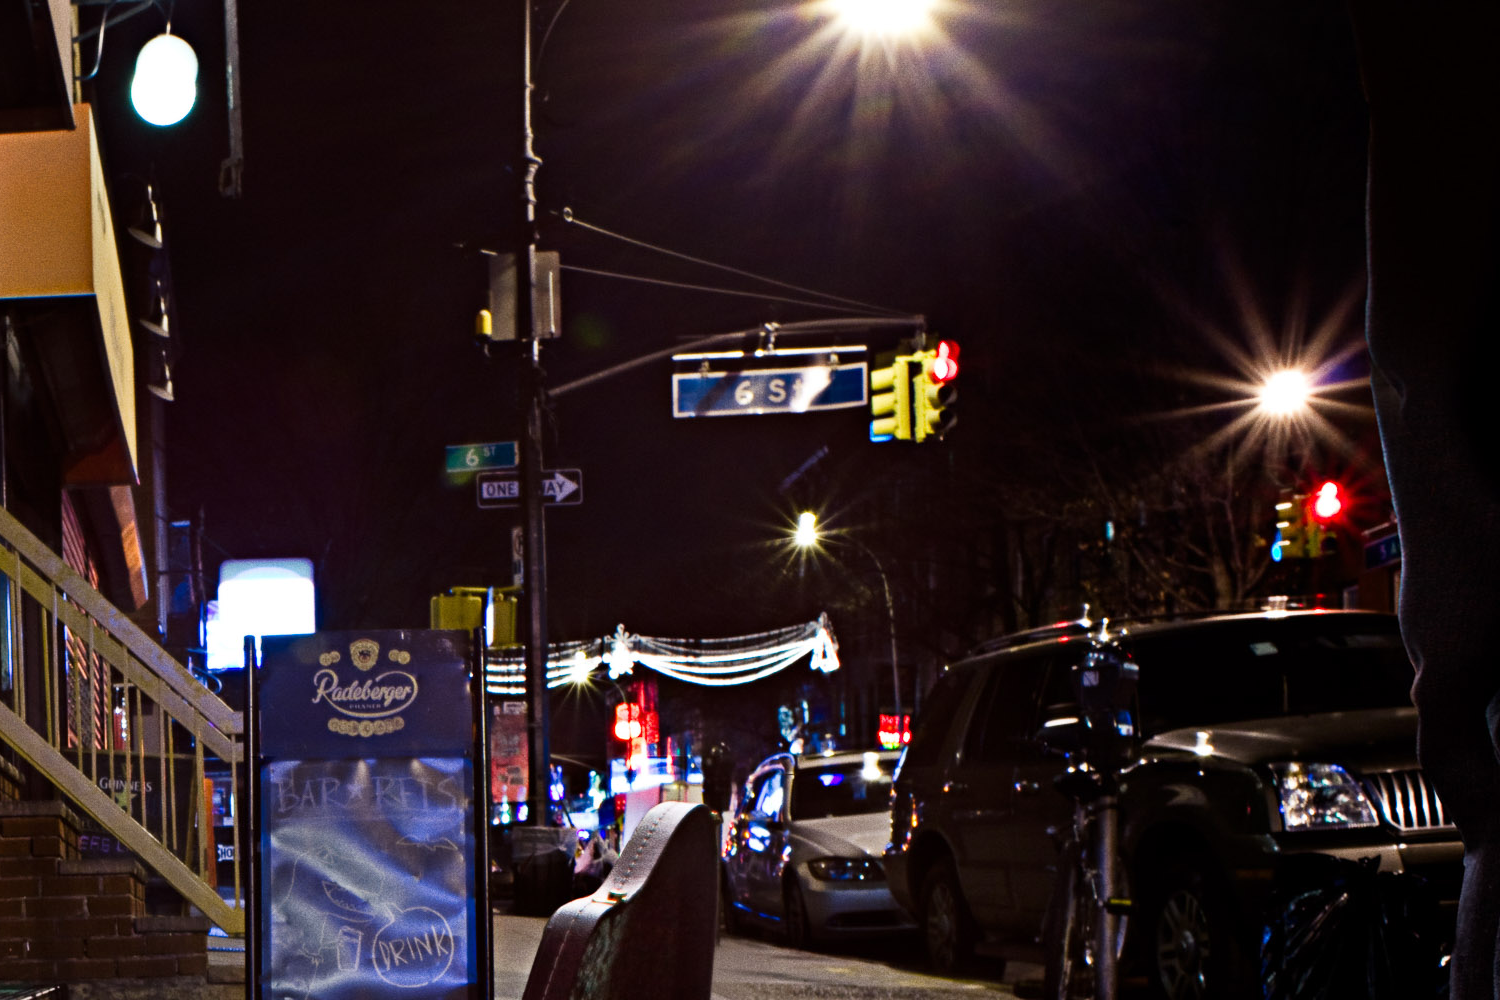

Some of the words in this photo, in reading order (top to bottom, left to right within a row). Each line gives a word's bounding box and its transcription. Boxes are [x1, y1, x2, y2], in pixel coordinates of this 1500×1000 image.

[735, 380, 754, 406] 6
[466, 448, 479, 467] 6
[483, 446, 496, 457] ST
[486, 483, 516, 497] ONE
[312, 669, 416, 710] Radeberger
[99, 777, 152, 792] GUINNES
[278, 773, 346, 813] BAR
[379, 925, 449, 971] DRINK
